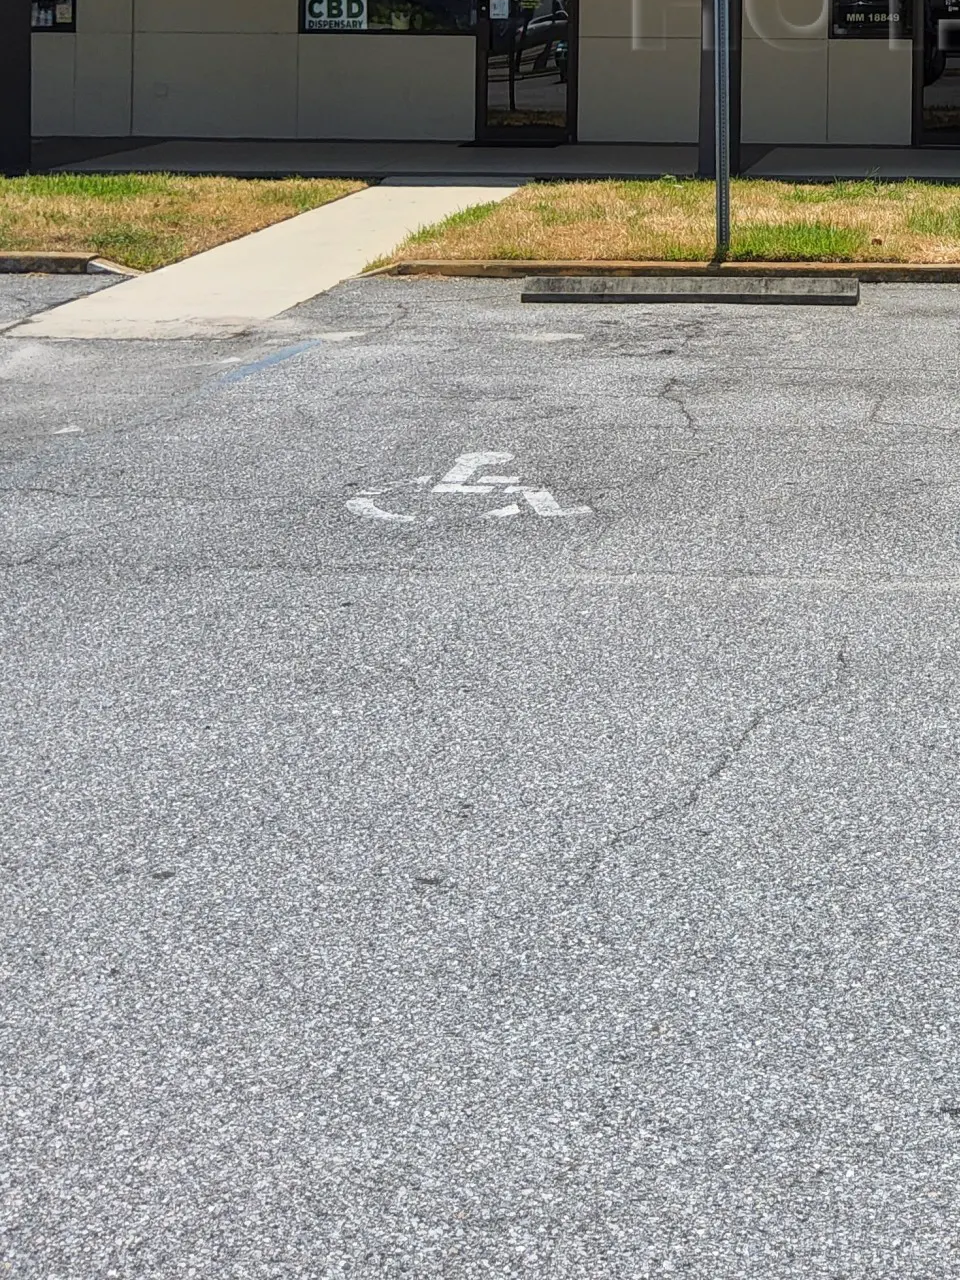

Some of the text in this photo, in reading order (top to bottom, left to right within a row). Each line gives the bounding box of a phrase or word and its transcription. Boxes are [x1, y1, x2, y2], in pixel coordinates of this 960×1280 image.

[847, 13, 900, 22] MM 18849
[308, 19, 364, 29] DISPENSARY
